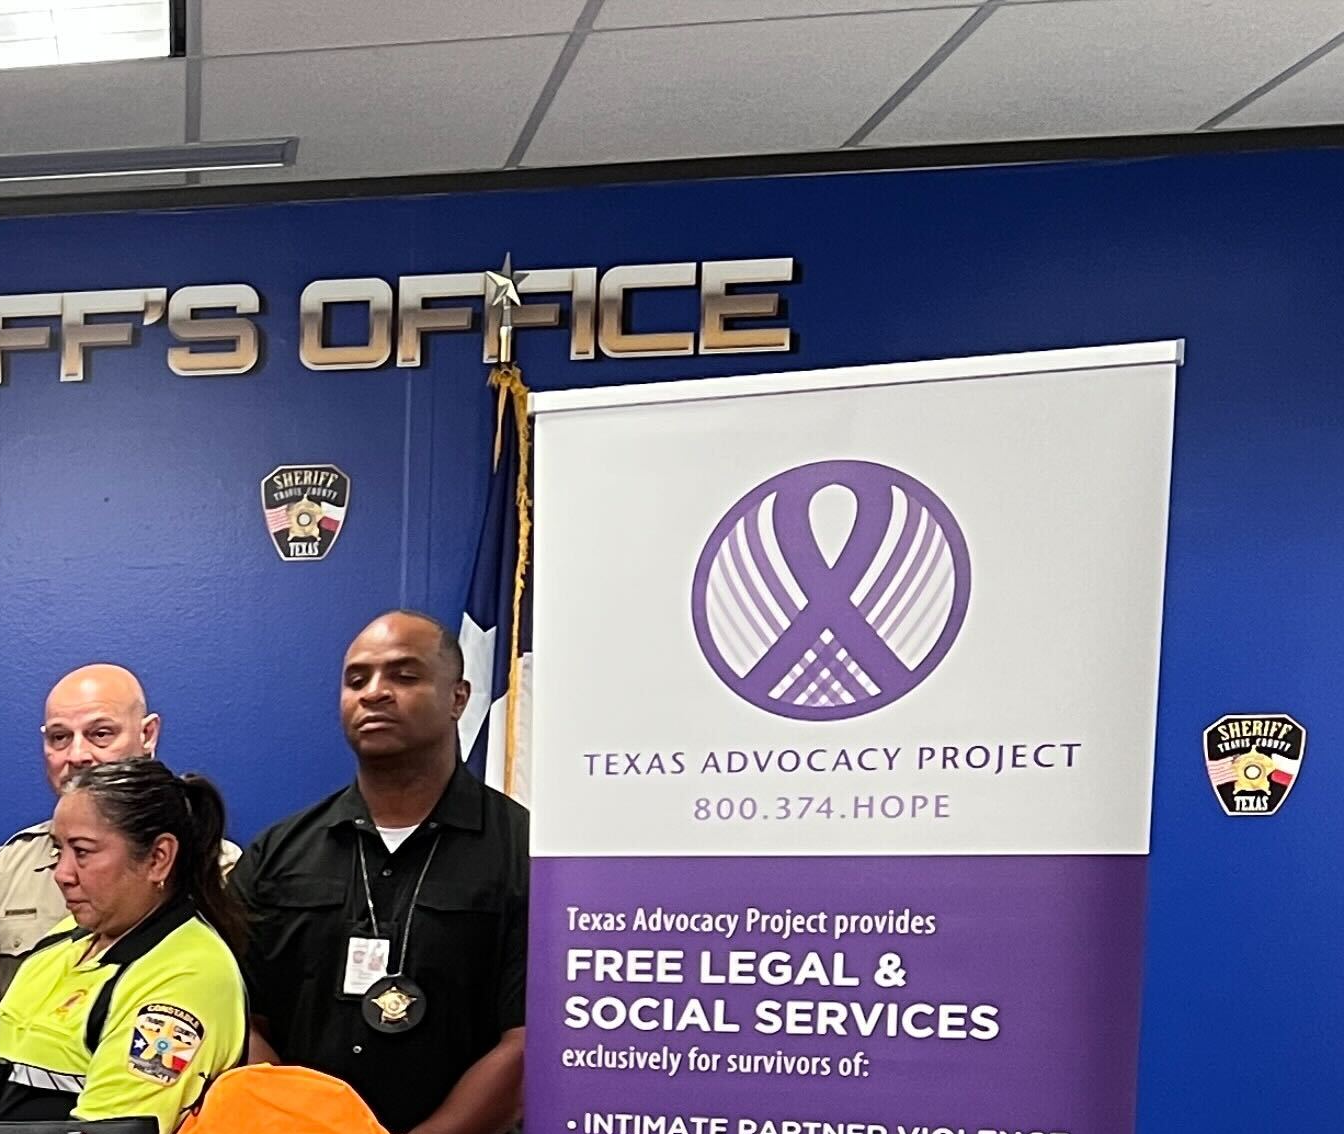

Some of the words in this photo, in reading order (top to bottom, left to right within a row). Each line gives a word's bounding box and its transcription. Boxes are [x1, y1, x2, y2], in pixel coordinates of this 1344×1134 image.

[299, 257, 793, 370] OFFICE
[273, 470, 339, 489] SHERIFF
[289, 542, 319, 556] TEXAS
[1218, 721, 1292, 741] SHERIFF
[1218, 738, 1250, 753] TRAVIS
[1256, 737, 1291, 752] COUNTY
[584, 752, 684, 775] TEXAS
[701, 748, 900, 773] ADVOCACY
[919, 744, 1081, 773] PROJECT
[694, 795, 949, 820] 800.374.HOPE
[1234, 795, 1268, 811] TEXAS
[567, 907, 625, 931] Texas
[633, 908, 738, 938] Advocacy
[747, 908, 827, 939] Project
[835, 909, 935, 939] provides
[568, 950, 683, 982] FREE
[701, 951, 859, 986] LEGAL
[874, 953, 905, 987] &
[565, 996, 739, 1032] SOCIAL
[755, 1000, 999, 1039] SERVICES
[563, 1044, 681, 1076] exclusively
[688, 1047, 720, 1071] for
[728, 1051, 830, 1075] survivors
[839, 1052, 869, 1077] of:
